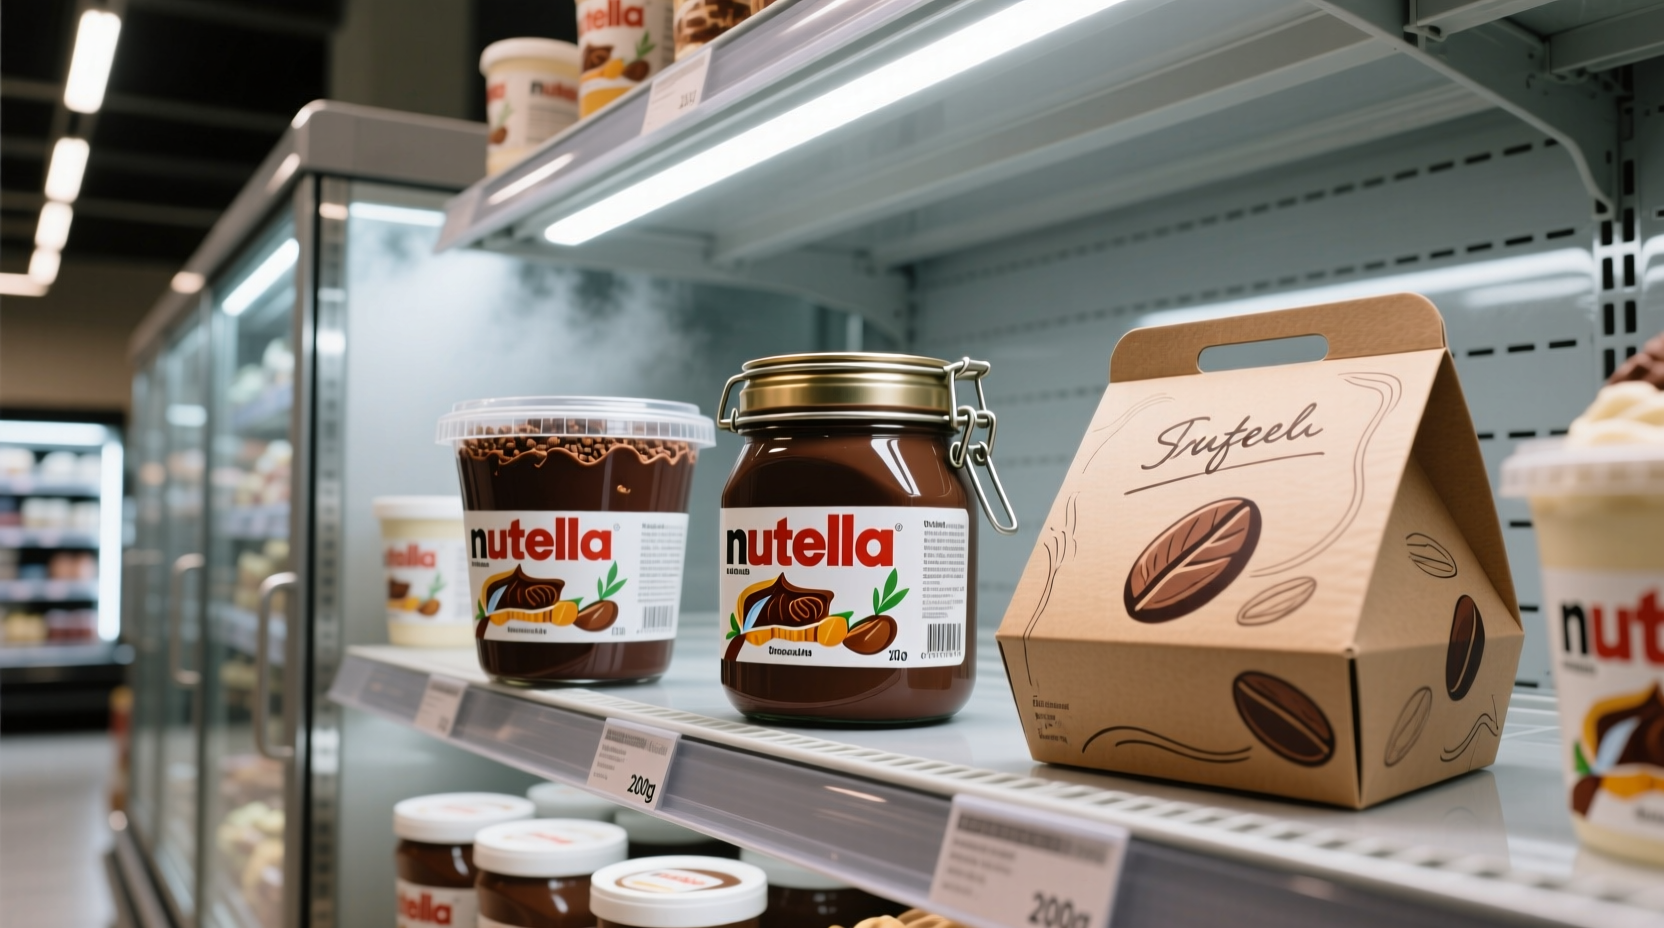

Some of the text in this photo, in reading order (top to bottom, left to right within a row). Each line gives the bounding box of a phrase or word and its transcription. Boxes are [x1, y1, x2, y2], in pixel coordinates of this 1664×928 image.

[470, 517, 612, 561] nutella
[726, 514, 894, 567] nutella
[627, 774, 656, 803] 200g
